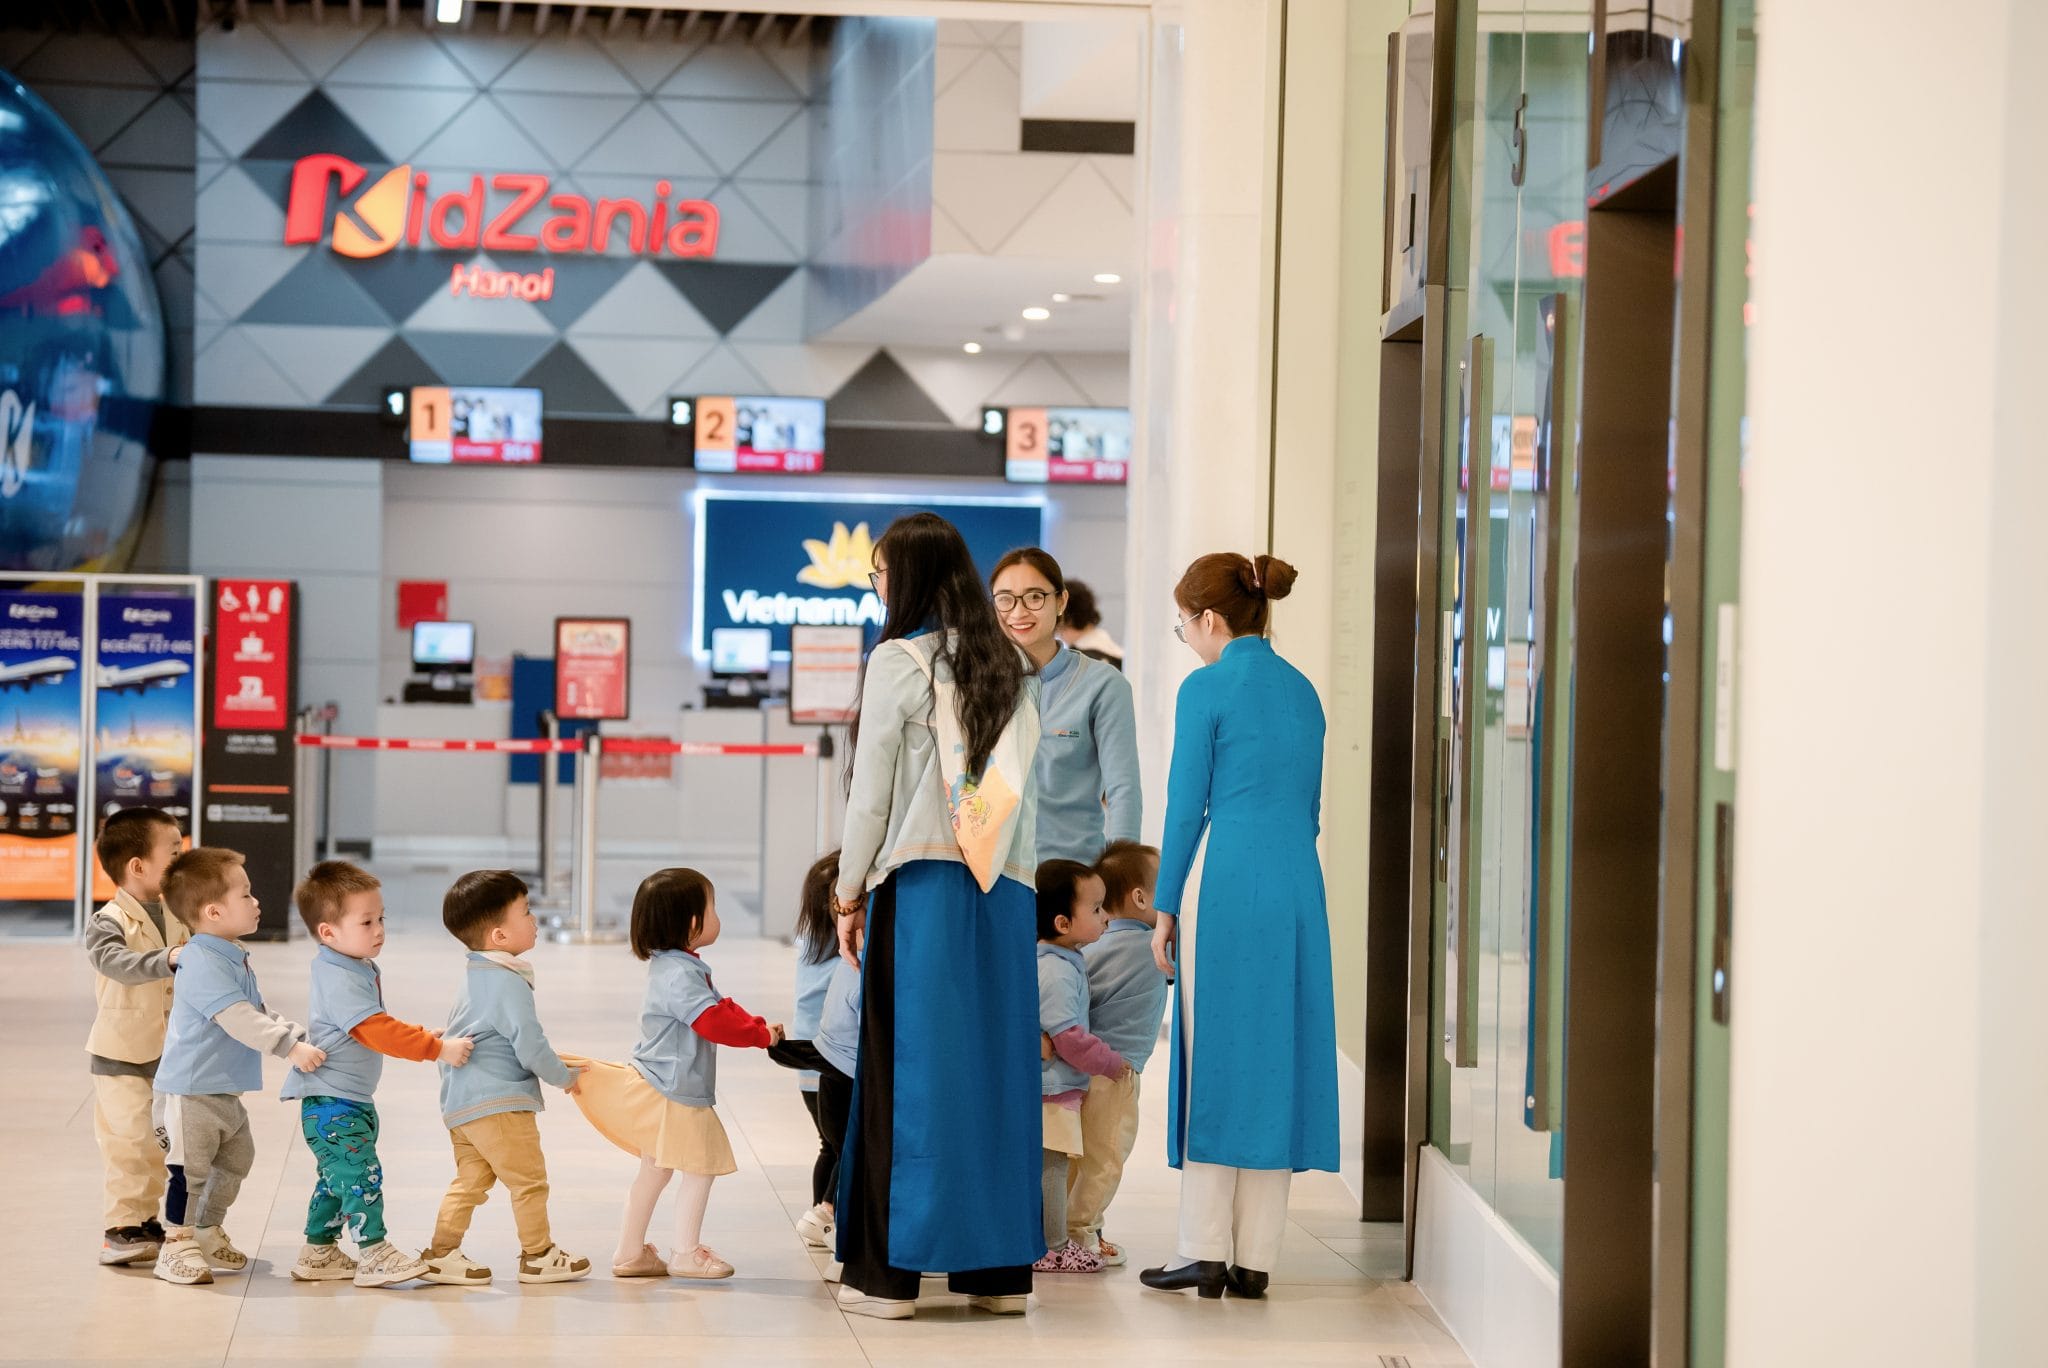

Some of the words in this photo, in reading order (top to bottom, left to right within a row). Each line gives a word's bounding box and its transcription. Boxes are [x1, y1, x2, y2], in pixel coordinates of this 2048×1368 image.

[285, 153, 720, 258] KidZania
[423, 403, 435, 431] 1
[706, 410, 724, 440] 2
[1019, 422, 1038, 451] 3
